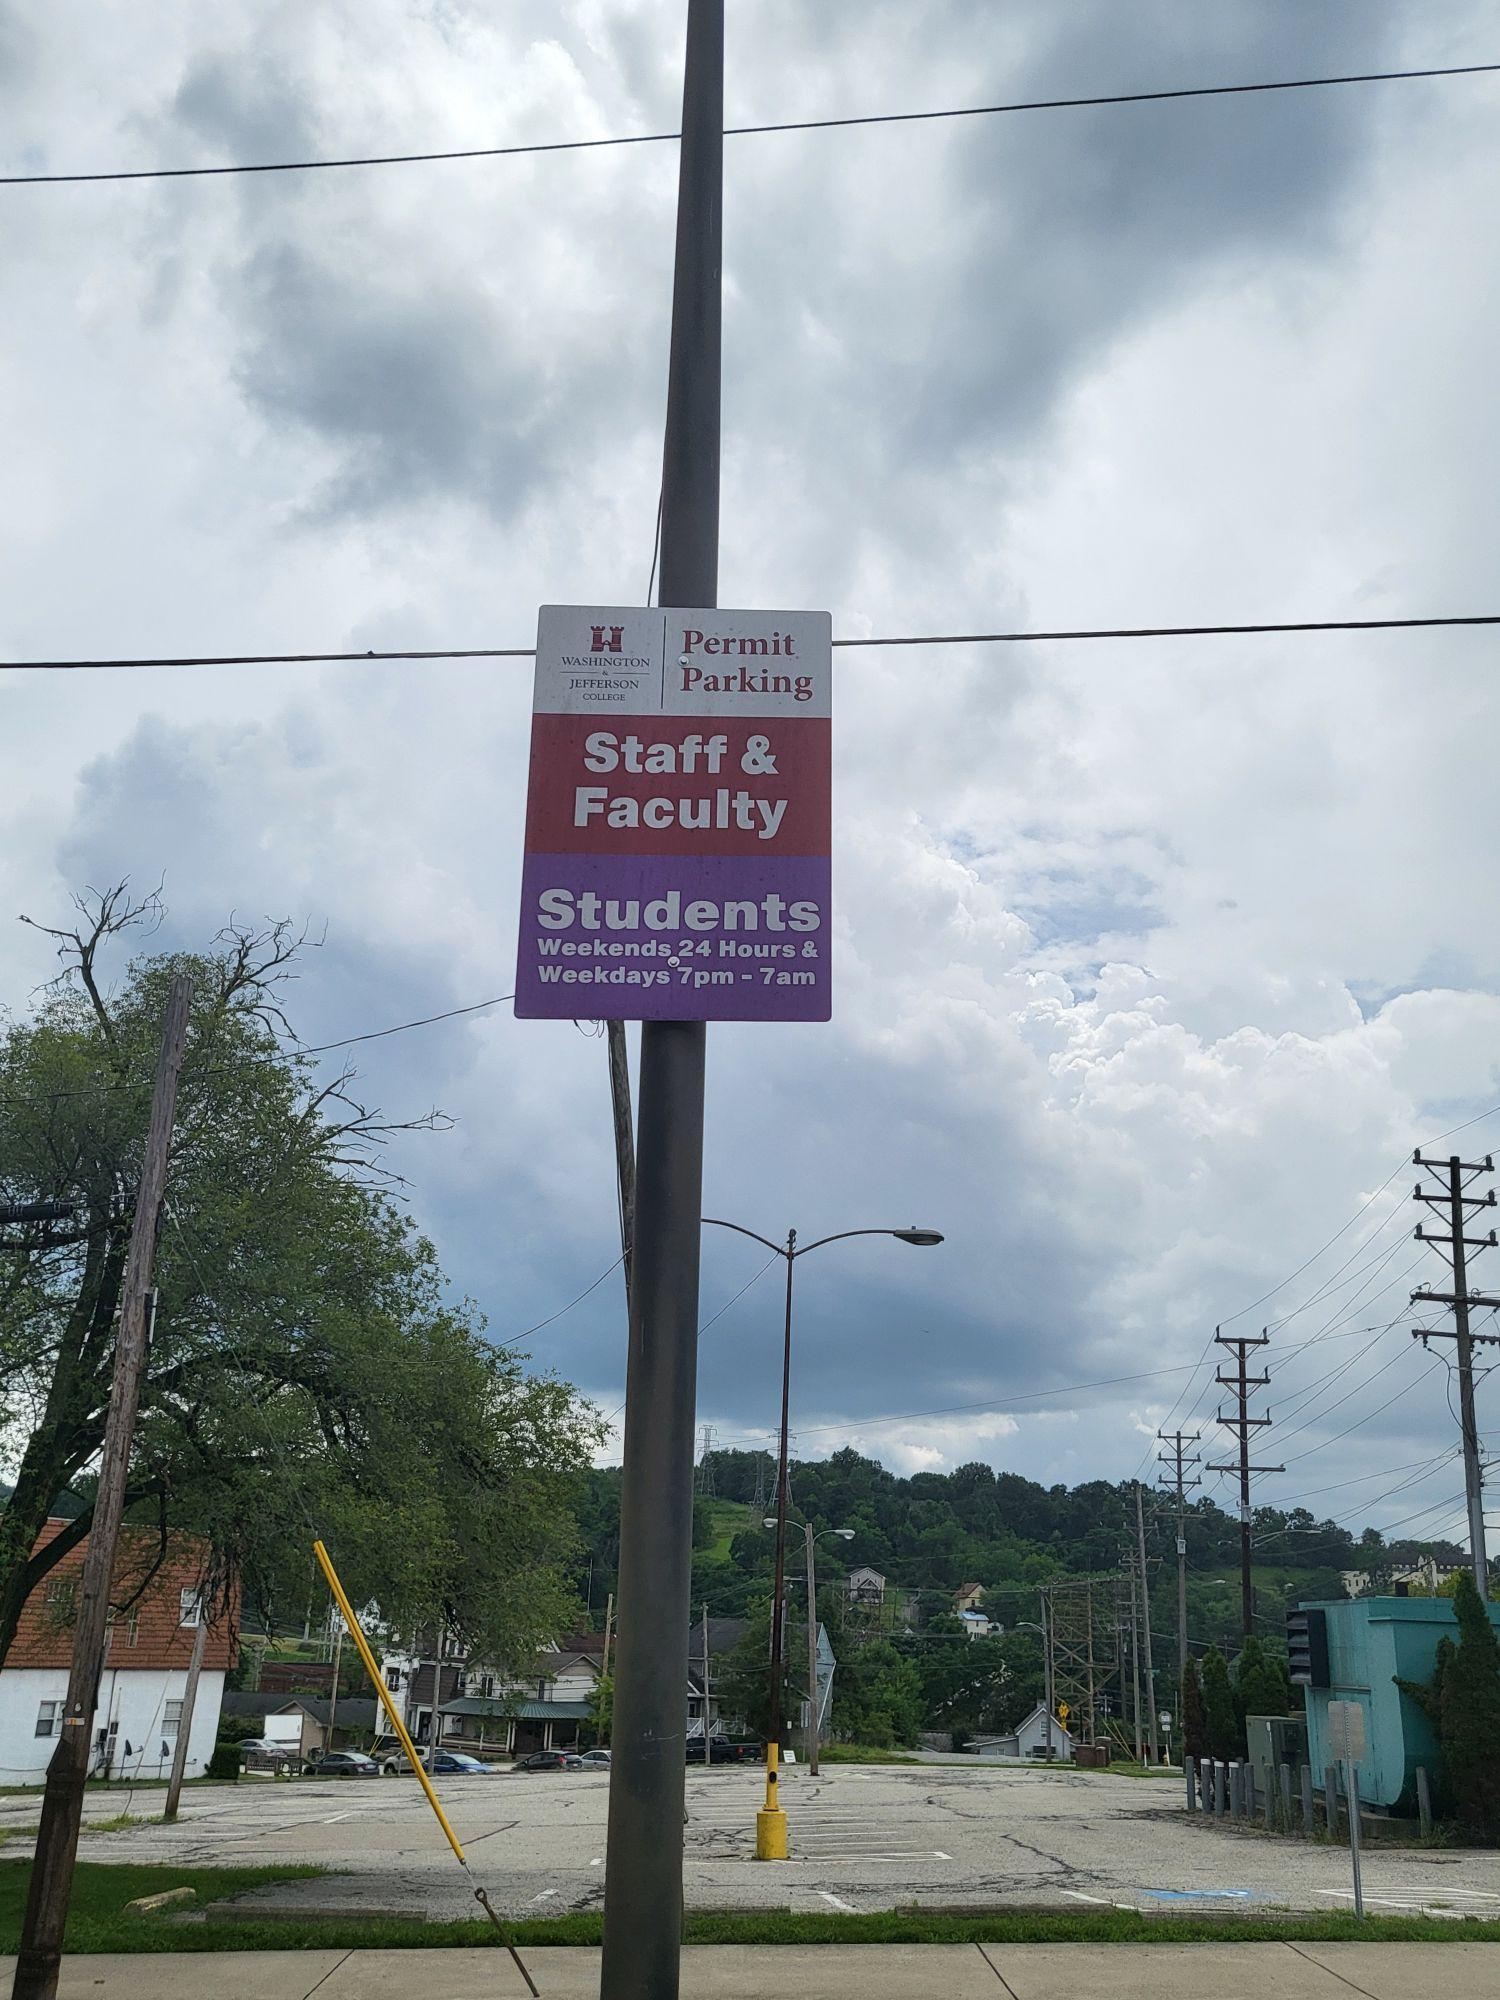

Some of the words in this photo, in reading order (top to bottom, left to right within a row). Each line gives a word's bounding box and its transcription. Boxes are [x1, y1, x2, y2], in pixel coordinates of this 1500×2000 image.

[682, 630, 795, 656] Permit
[562, 656, 650, 668] WASHINGTON
[569, 678, 639, 689] JEFFERSON
[680, 667, 813, 701] Parking
[582, 693, 626, 701] COLLEGE
[584, 732, 727, 774] Staff
[740, 735, 779, 775] &
[574, 786, 788, 839] Faculty
[537, 888, 821, 931] Students
[538, 938, 671, 957] Weekends
[678, 940, 711, 957] 24
[719, 941, 796, 958] Hours
[801, 941, 819, 958] &
[538, 965, 671, 987] Weekdays
[677, 967, 734, 988] 7pm
[760, 967, 816, 985] 7am
